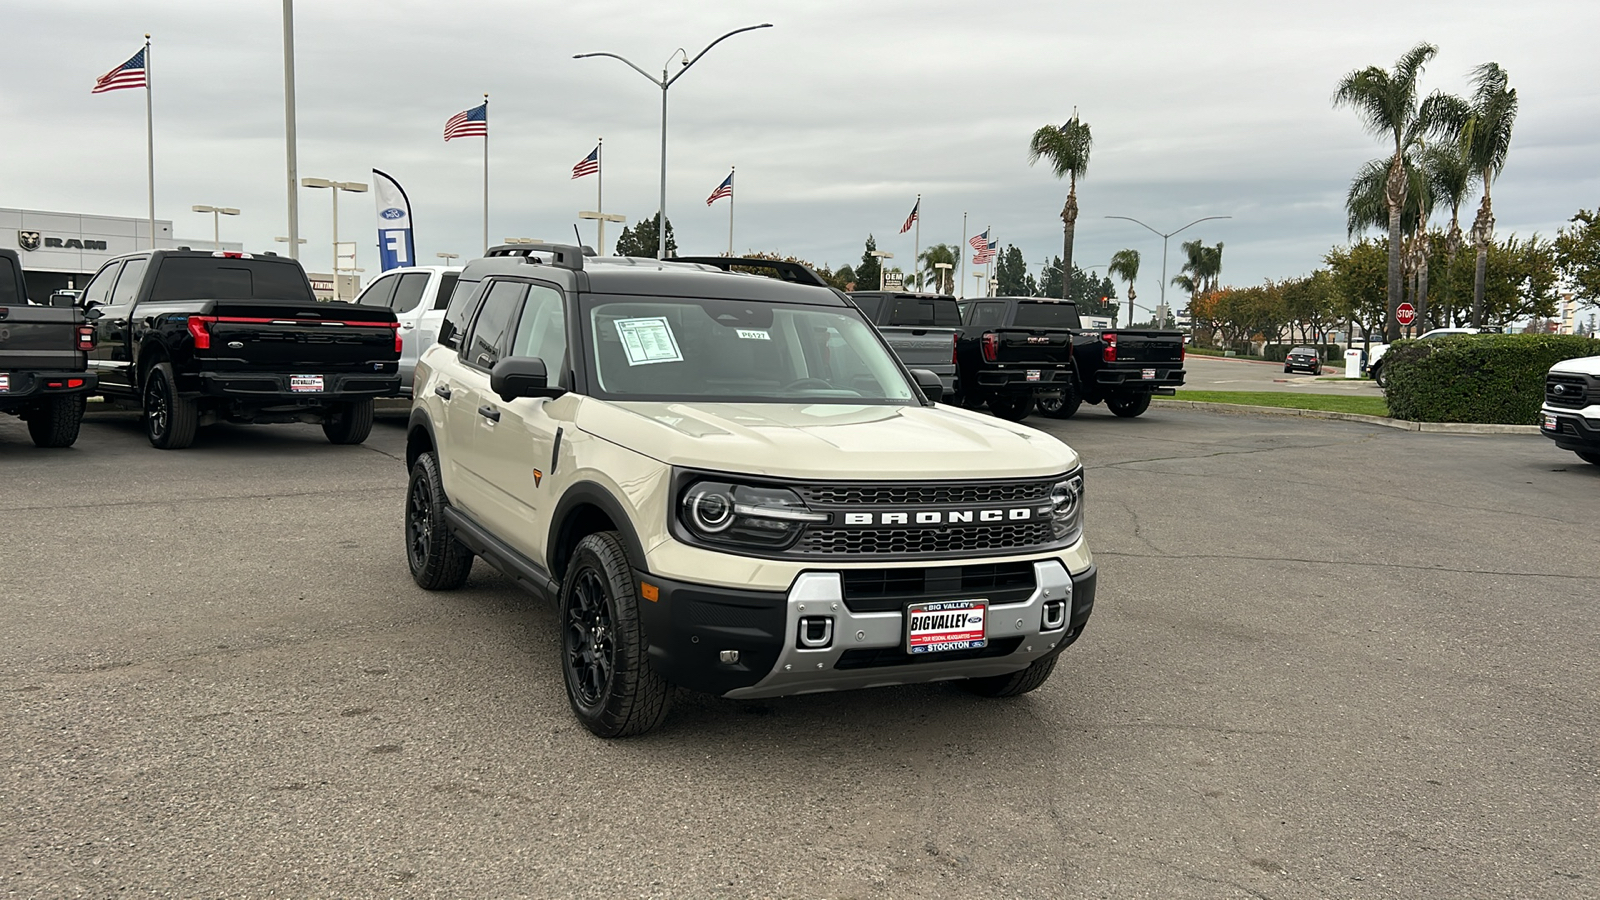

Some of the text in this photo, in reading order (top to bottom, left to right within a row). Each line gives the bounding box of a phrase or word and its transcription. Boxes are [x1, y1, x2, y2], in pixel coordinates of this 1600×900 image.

[44, 237, 107, 250] RAM
[1397, 309, 1413, 318] STOP
[845, 508, 1031, 525] BRONCO
[943, 602, 970, 610] VALLEY
[911, 613, 969, 631] BIGVALLEY
[927, 641, 970, 652] STOCKTON
